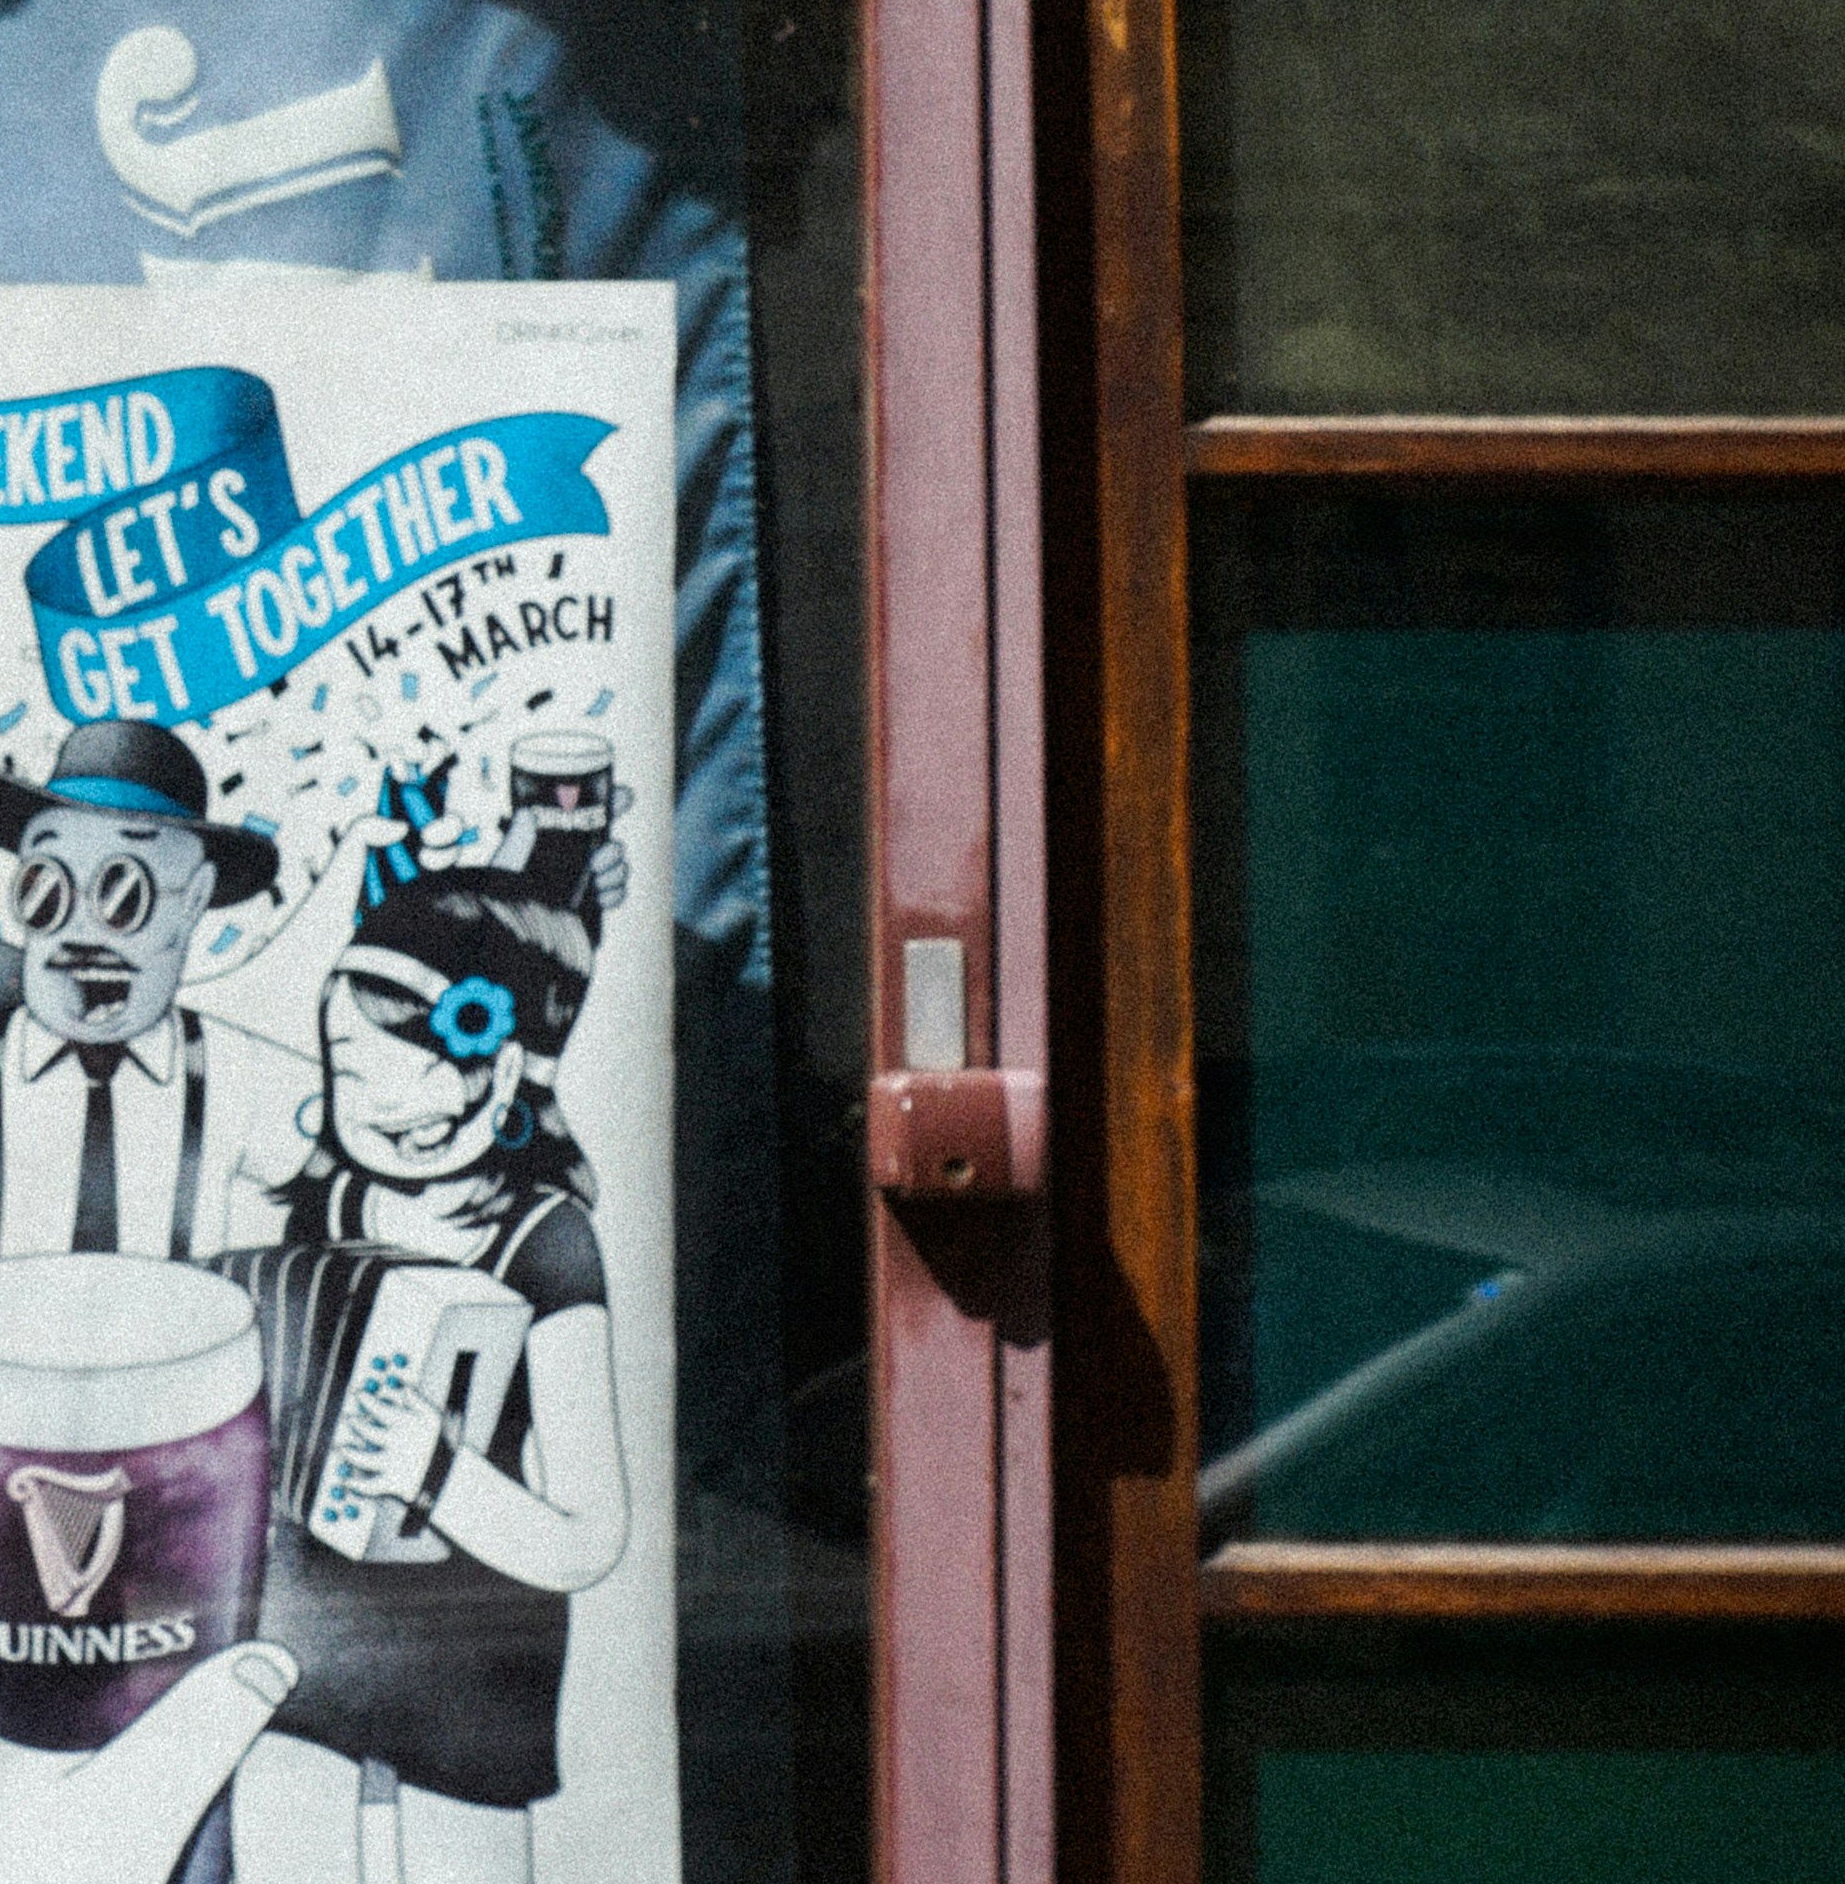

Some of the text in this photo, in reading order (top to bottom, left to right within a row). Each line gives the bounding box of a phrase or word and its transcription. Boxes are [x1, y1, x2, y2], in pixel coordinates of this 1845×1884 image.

[59, 438, 523, 720] GET TOGETHER
[78, 468, 261, 616] LET'S
[435, 593, 614, 681] MARCH
